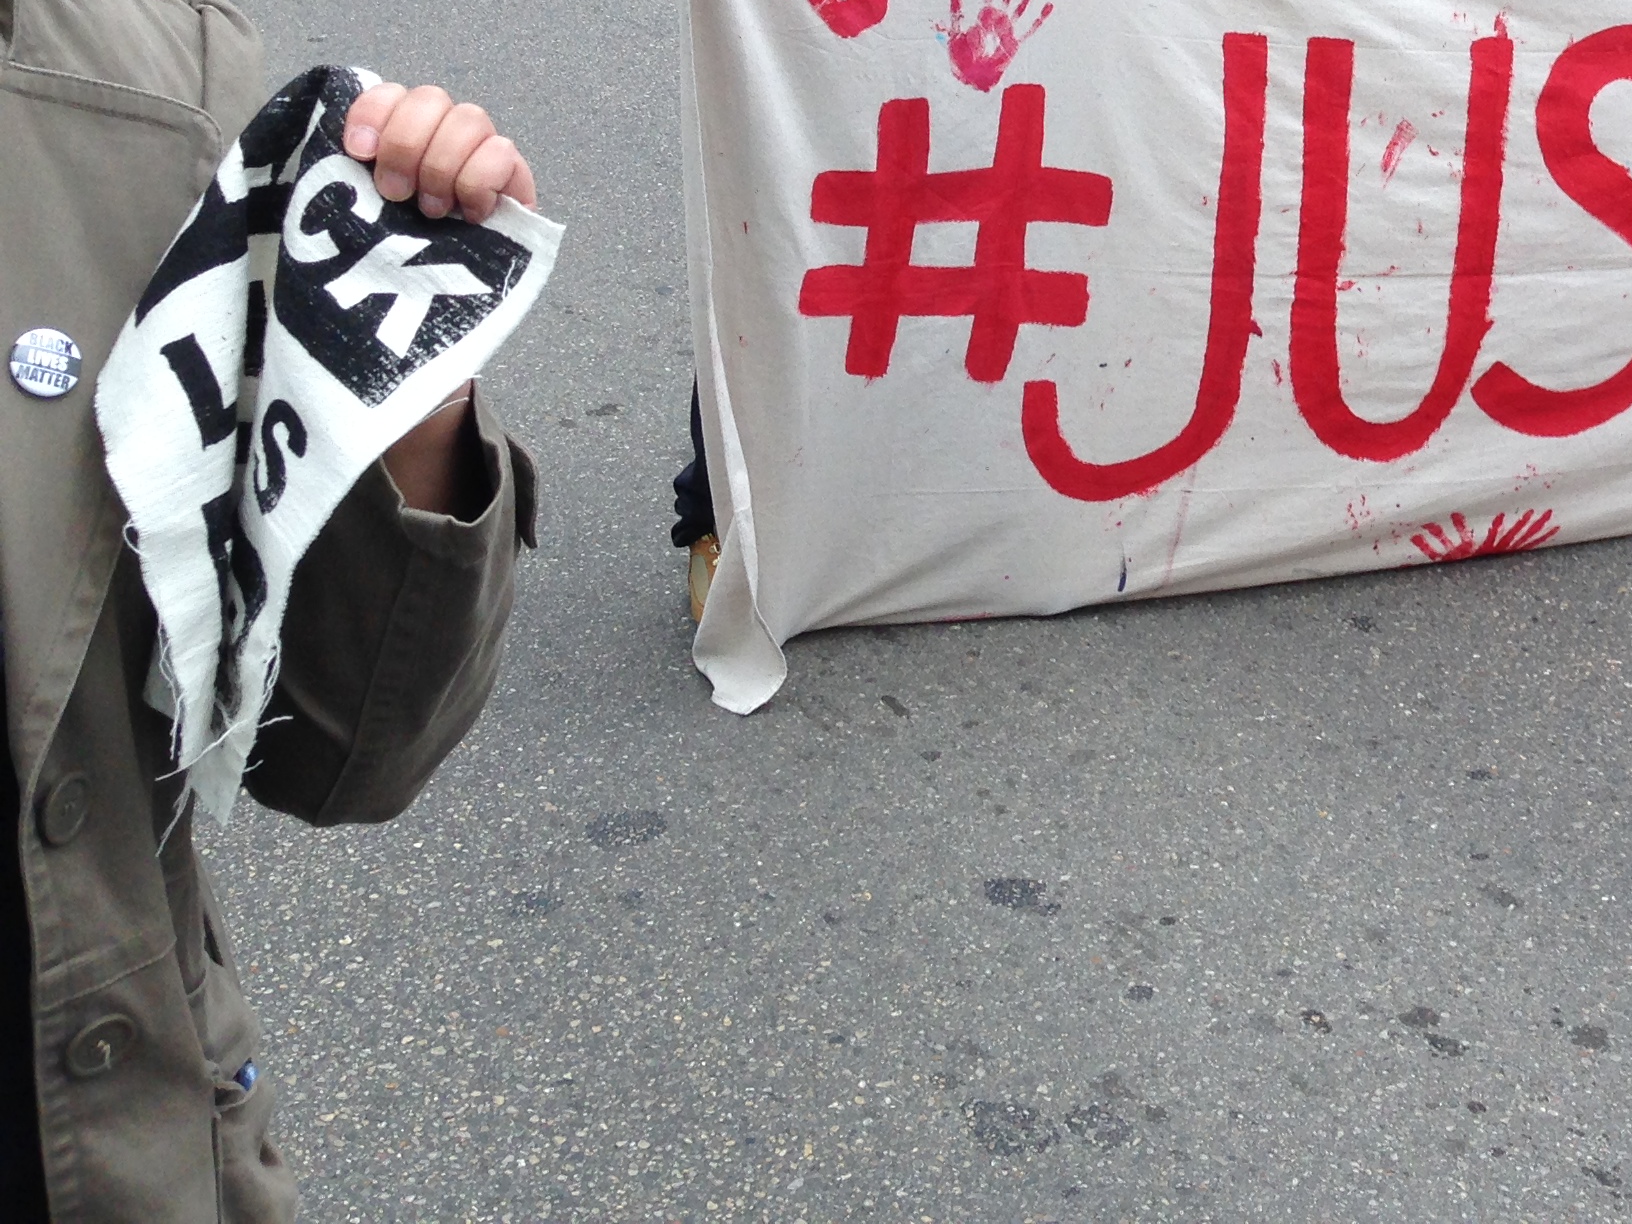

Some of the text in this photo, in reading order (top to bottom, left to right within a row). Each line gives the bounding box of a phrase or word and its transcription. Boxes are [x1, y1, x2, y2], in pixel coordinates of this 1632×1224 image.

[30, 332, 73, 355] BLACK
[27, 348, 69, 372] LIVES
[16, 364, 70, 391] MATTER
